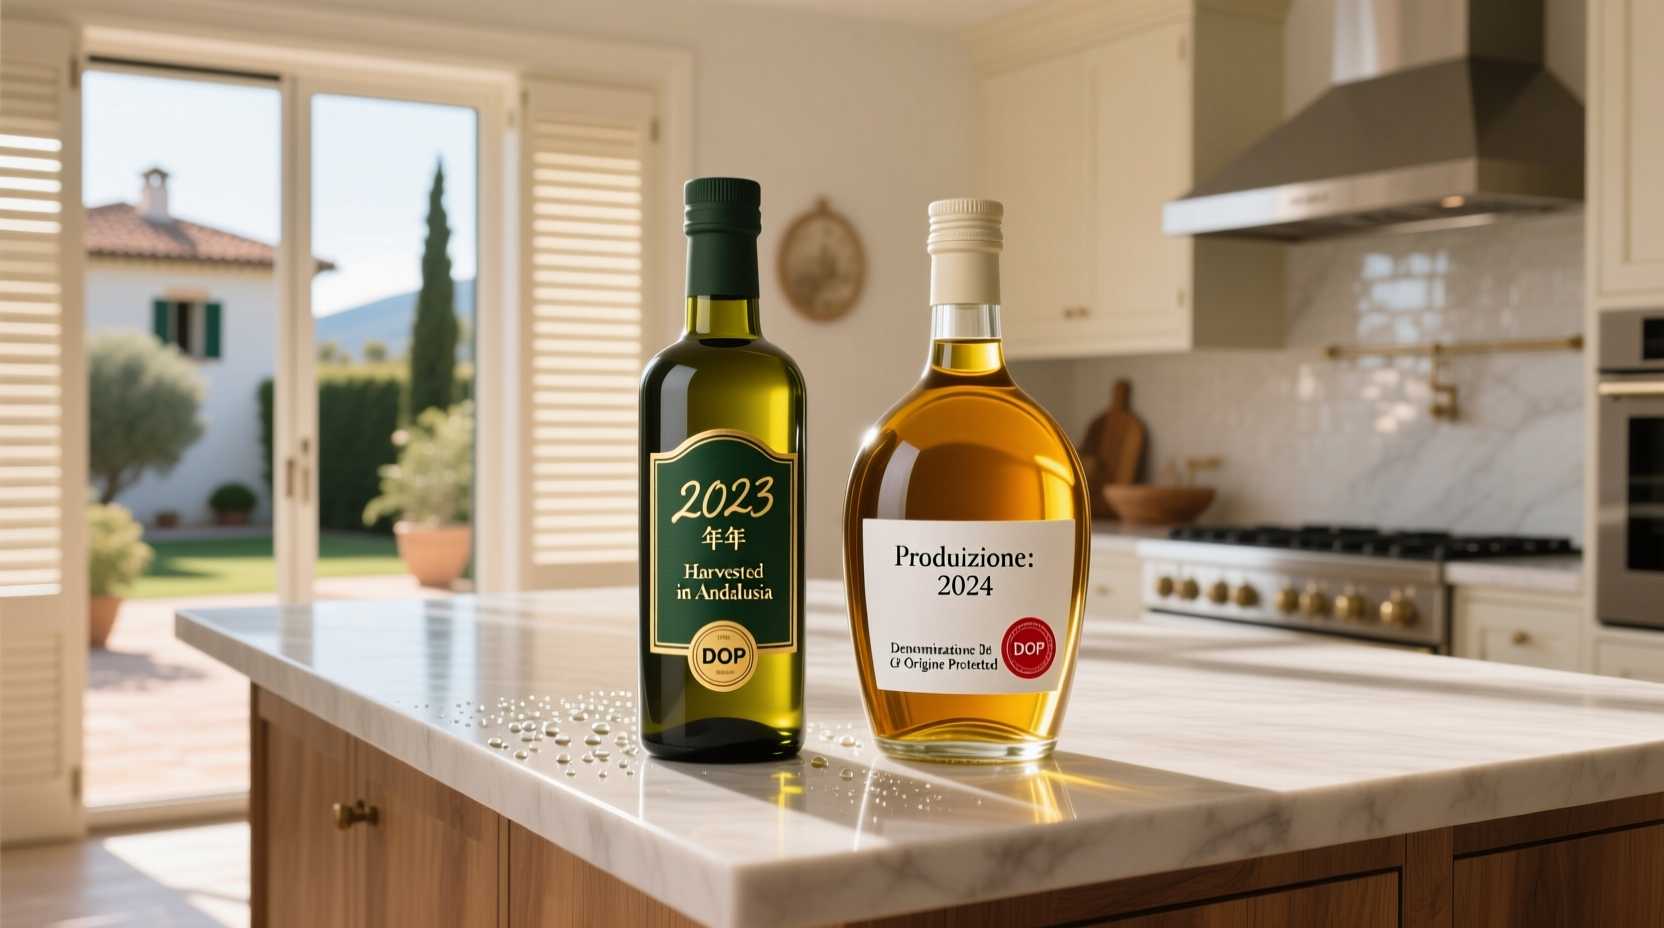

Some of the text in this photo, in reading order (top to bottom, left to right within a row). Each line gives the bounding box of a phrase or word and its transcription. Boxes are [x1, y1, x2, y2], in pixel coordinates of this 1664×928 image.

[671, 476, 774, 524] 2023
[701, 525, 746, 551] 年年
[894, 544, 1034, 568] Produizione:
[676, 583, 773, 600] in Andalusia
[937, 575, 994, 596] 2024
[702, 647, 746, 665] DOP
[1013, 641, 1045, 656] DOP
[904, 656, 945, 672] Origine
